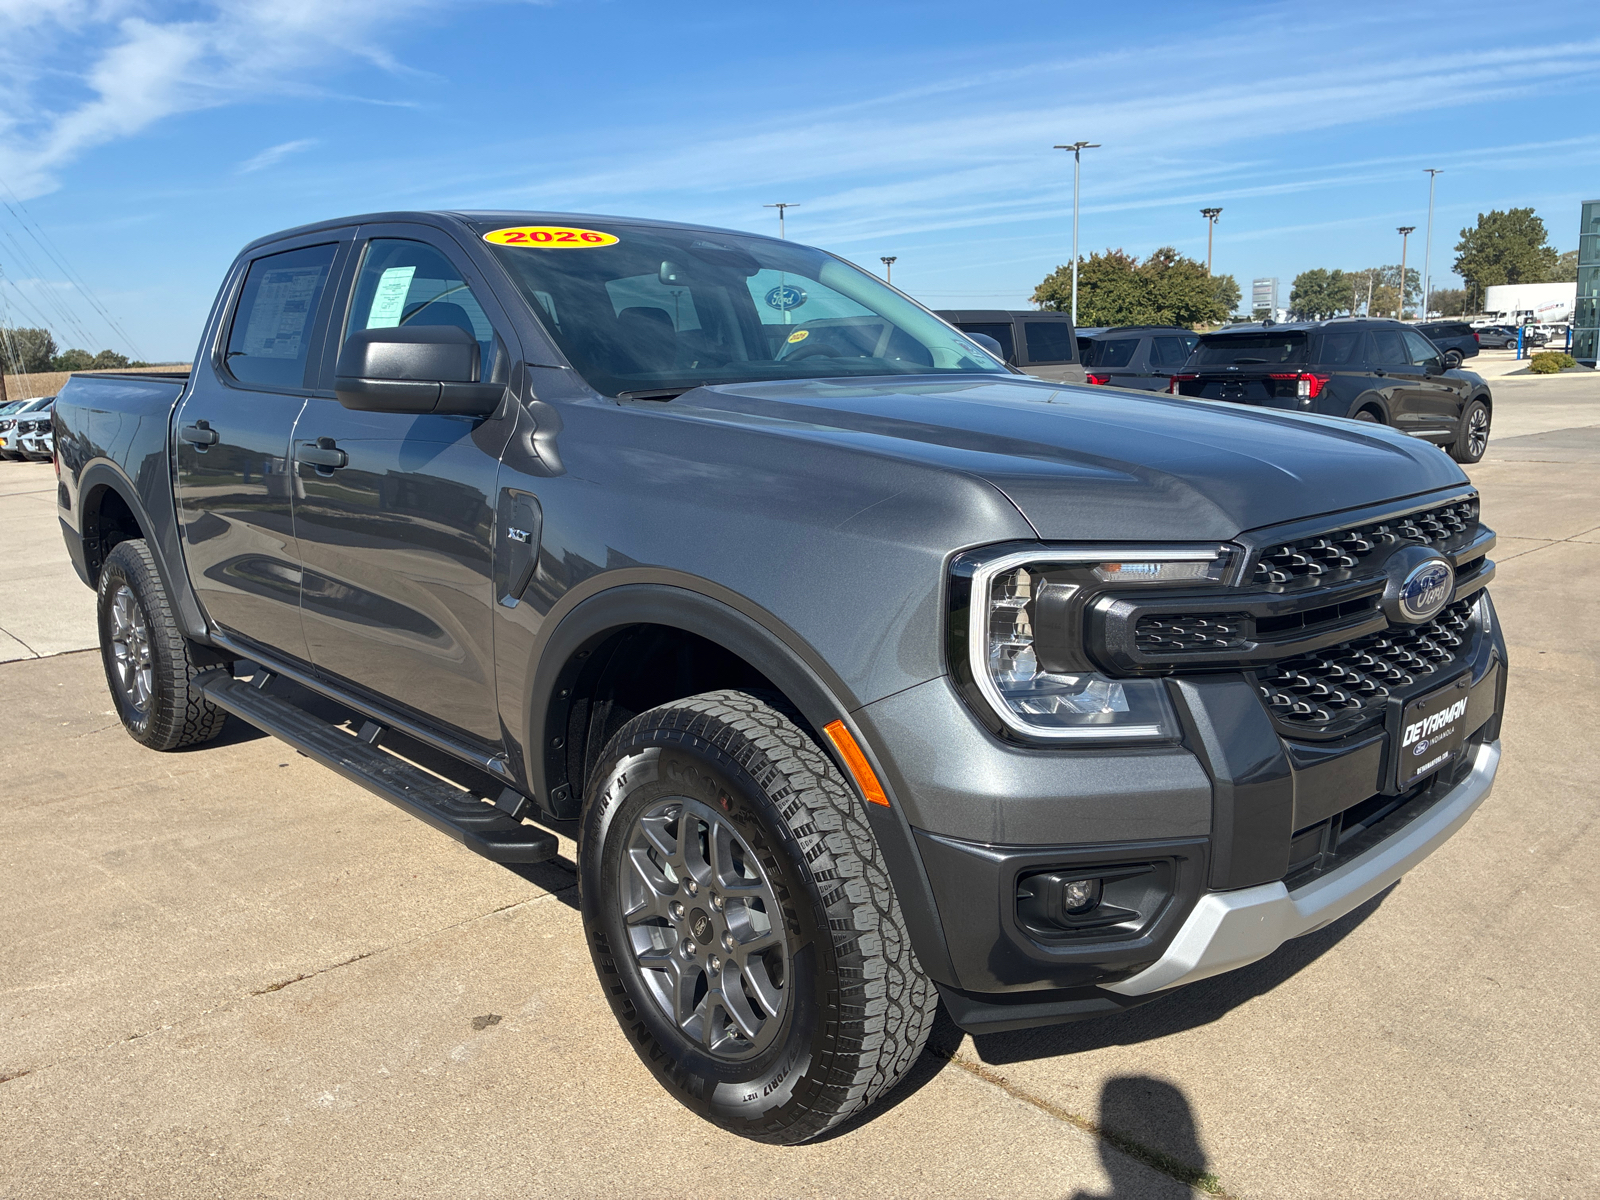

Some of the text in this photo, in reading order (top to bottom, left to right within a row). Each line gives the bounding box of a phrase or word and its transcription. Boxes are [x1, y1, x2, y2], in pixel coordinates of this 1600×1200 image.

[503, 231, 605, 244] 2026
[771, 290, 795, 305] Ford
[507, 526, 531, 543] XLT
[1416, 575, 1447, 608] Ford
[1402, 696, 1468, 748] DEYARMAN
[1429, 726, 1455, 747] INDIANOLA
[616, 772, 629, 790] AT
[592, 931, 706, 1101] WRANGLER
[742, 1092, 758, 1102] 112T
